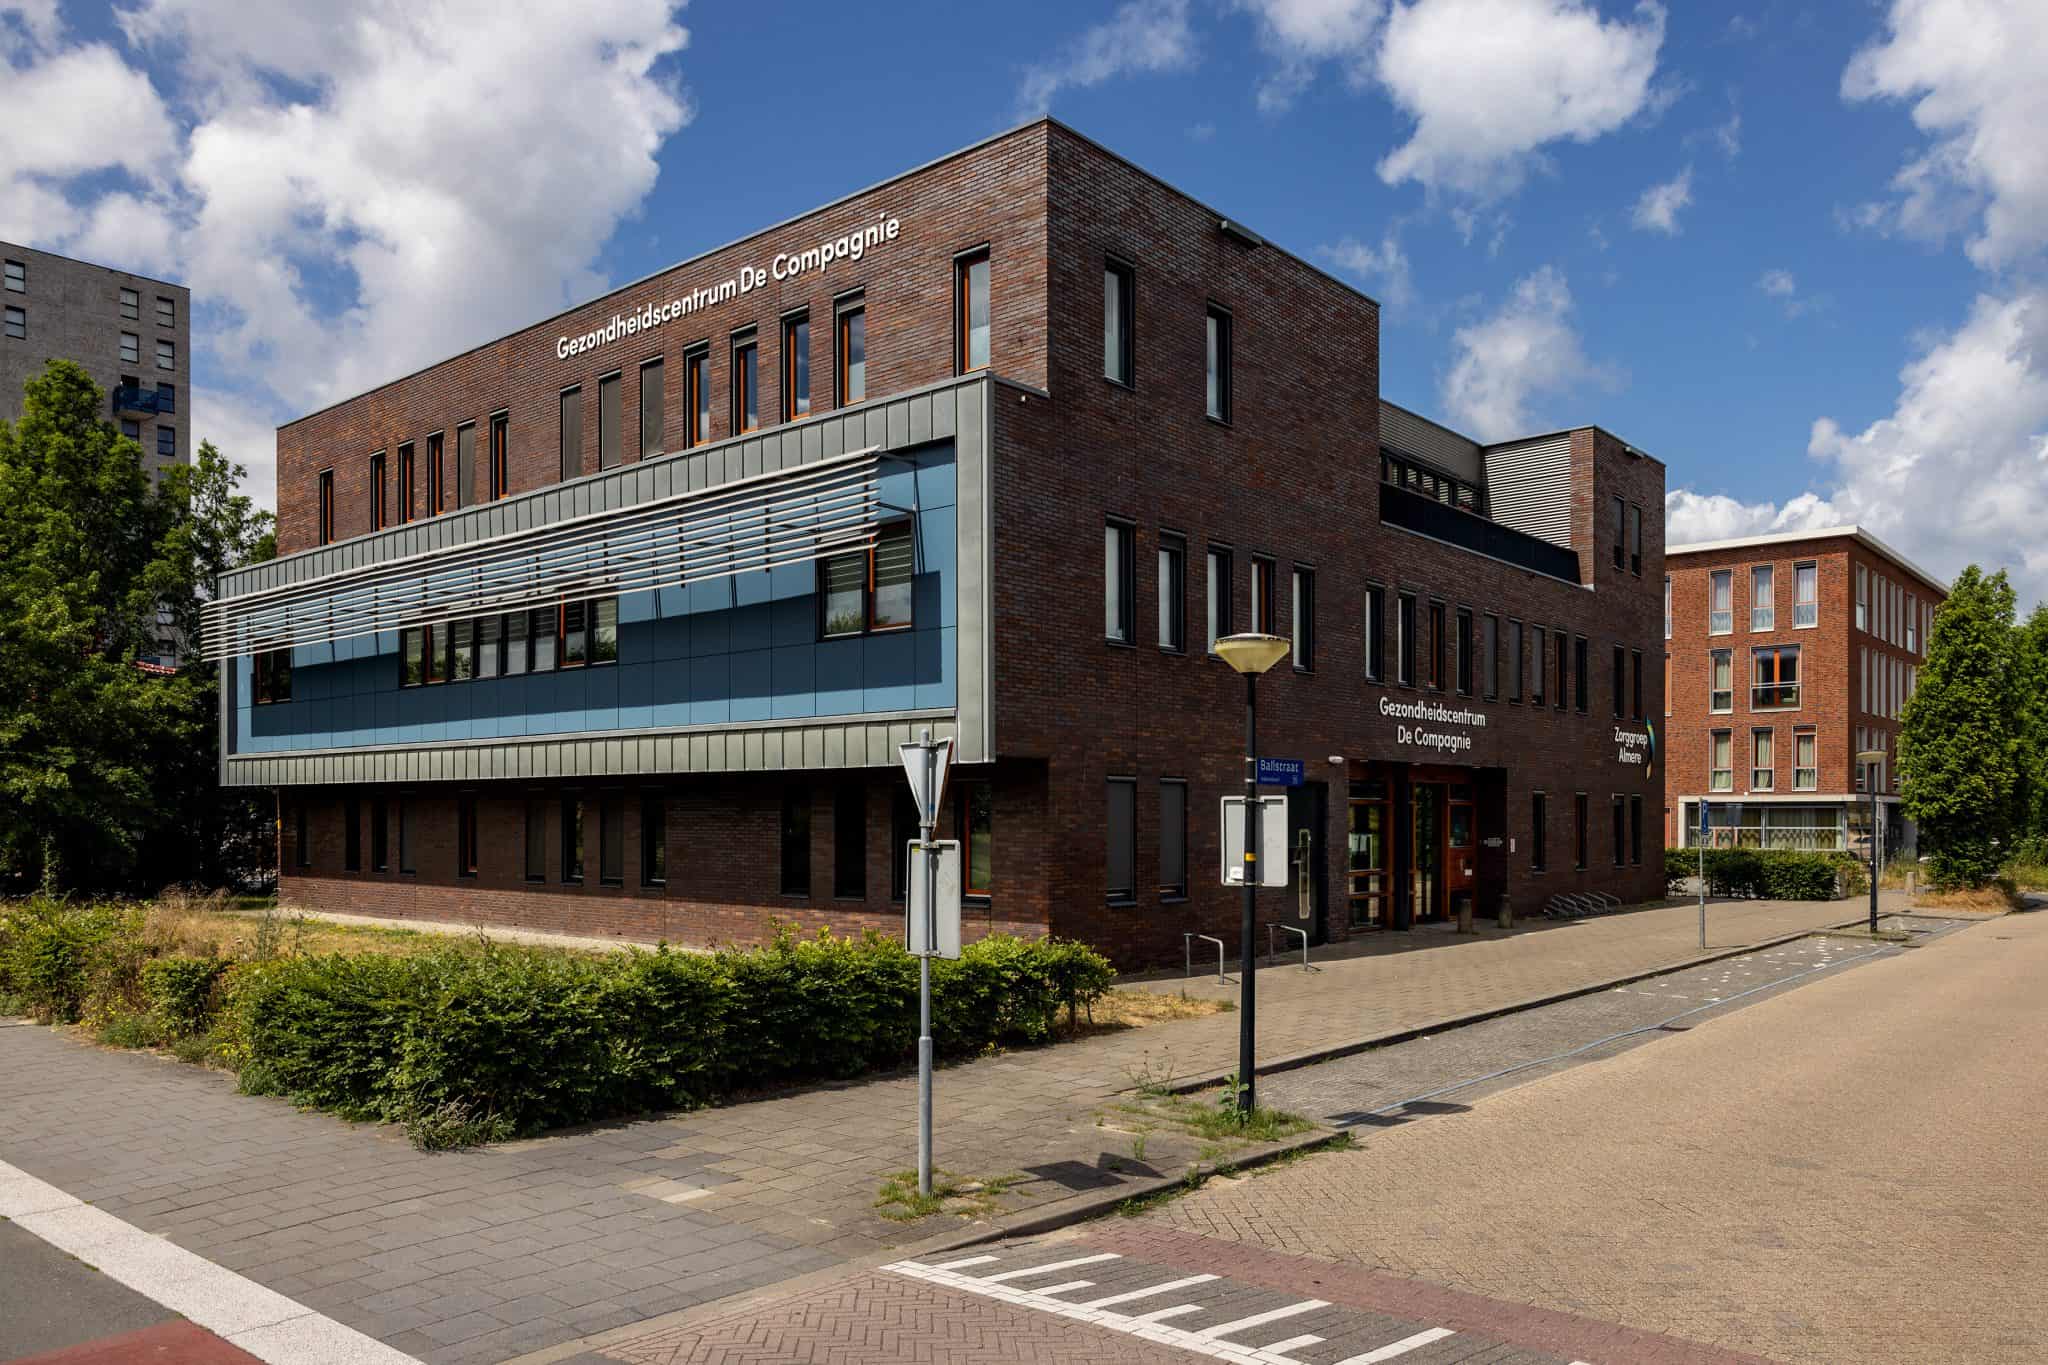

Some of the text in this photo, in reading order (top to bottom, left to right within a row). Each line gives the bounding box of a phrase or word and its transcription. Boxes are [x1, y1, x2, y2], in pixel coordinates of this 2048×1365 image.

[557, 213, 901, 360] Gezondheidscentrum De Compagnie
[1379, 696, 1486, 727] Gezondheidscentrum
[1397, 725, 1471, 754] De Compagnie
[1614, 726, 1648, 750] Zorggroep
[1618, 747, 1642, 765] Almere
